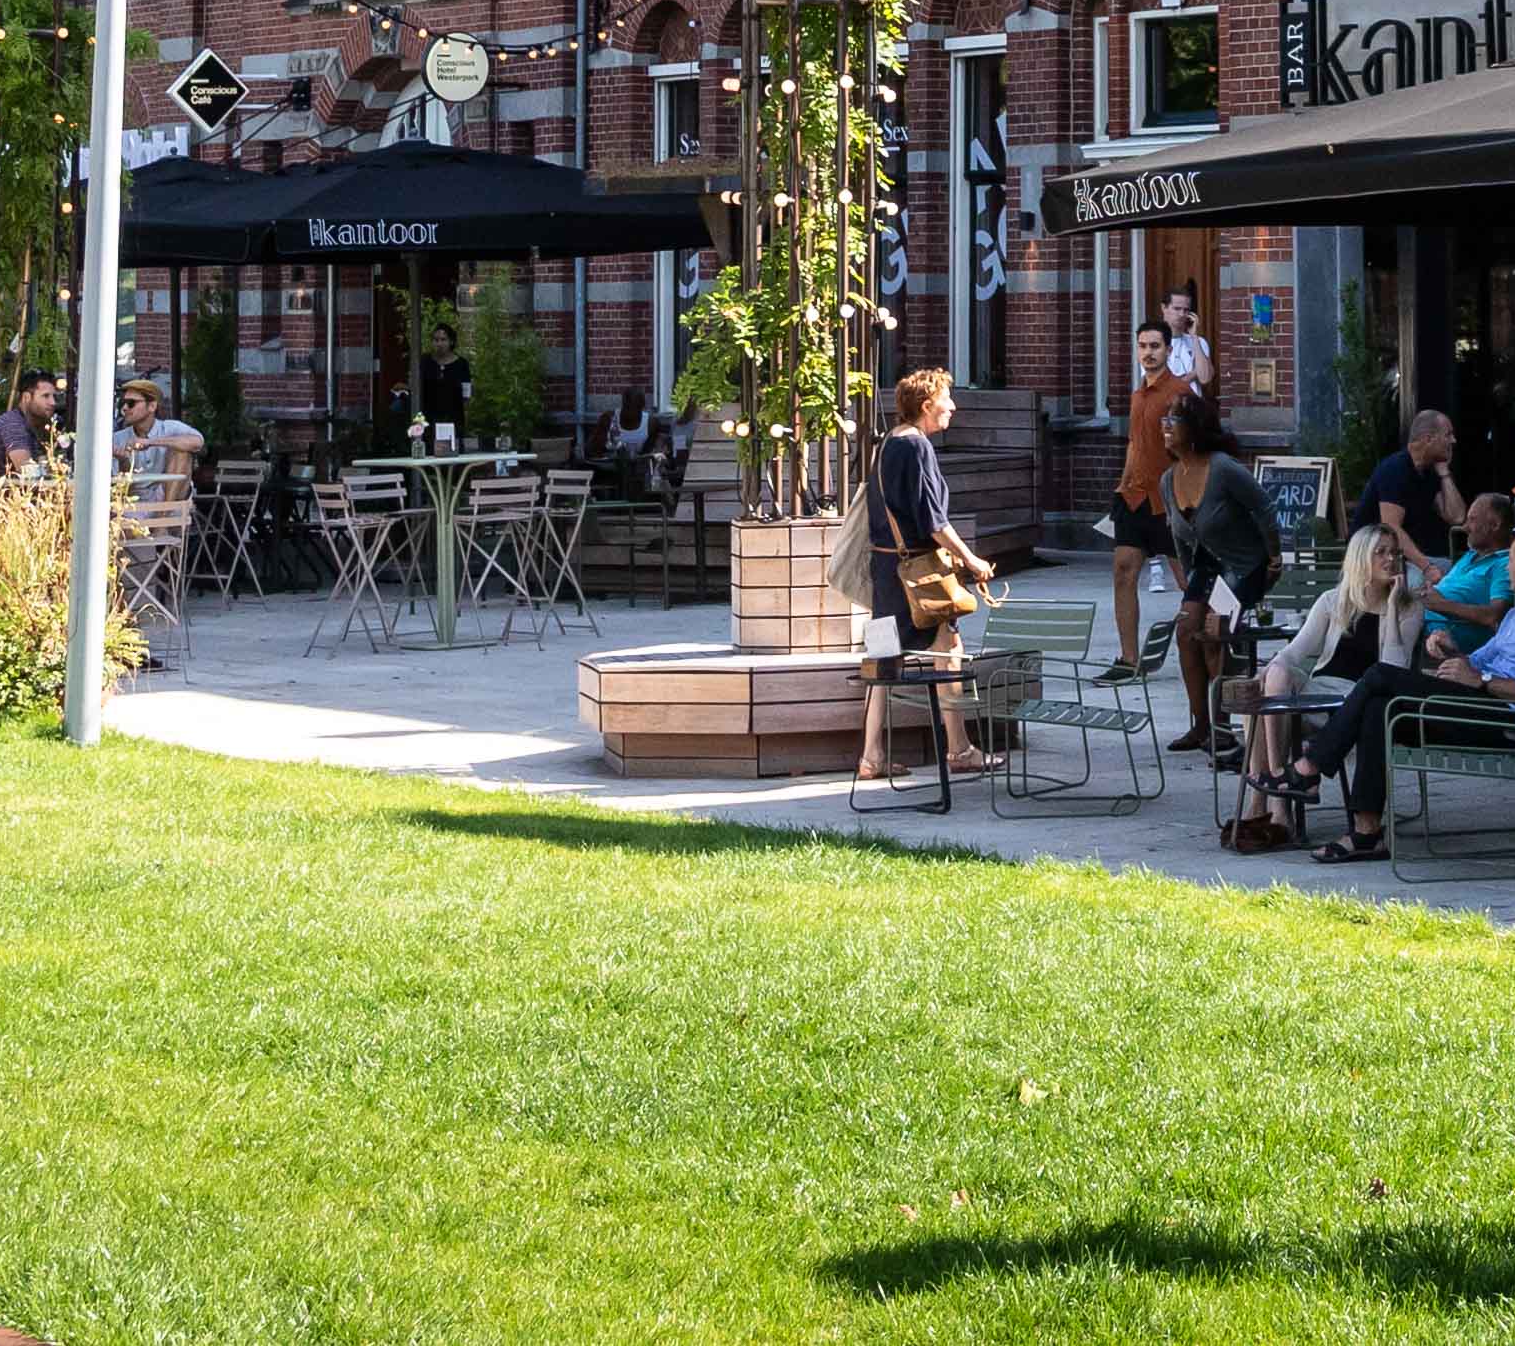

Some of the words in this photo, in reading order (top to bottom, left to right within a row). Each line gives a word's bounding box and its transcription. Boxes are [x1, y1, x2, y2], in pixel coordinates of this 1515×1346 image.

[437, 59, 476, 67] Conscious
[1287, 20, 1305, 87] BAR
[190, 85, 238, 95] Conscious
[1085, 171, 1202, 221] kantoor
[321, 218, 438, 246] kantoor
